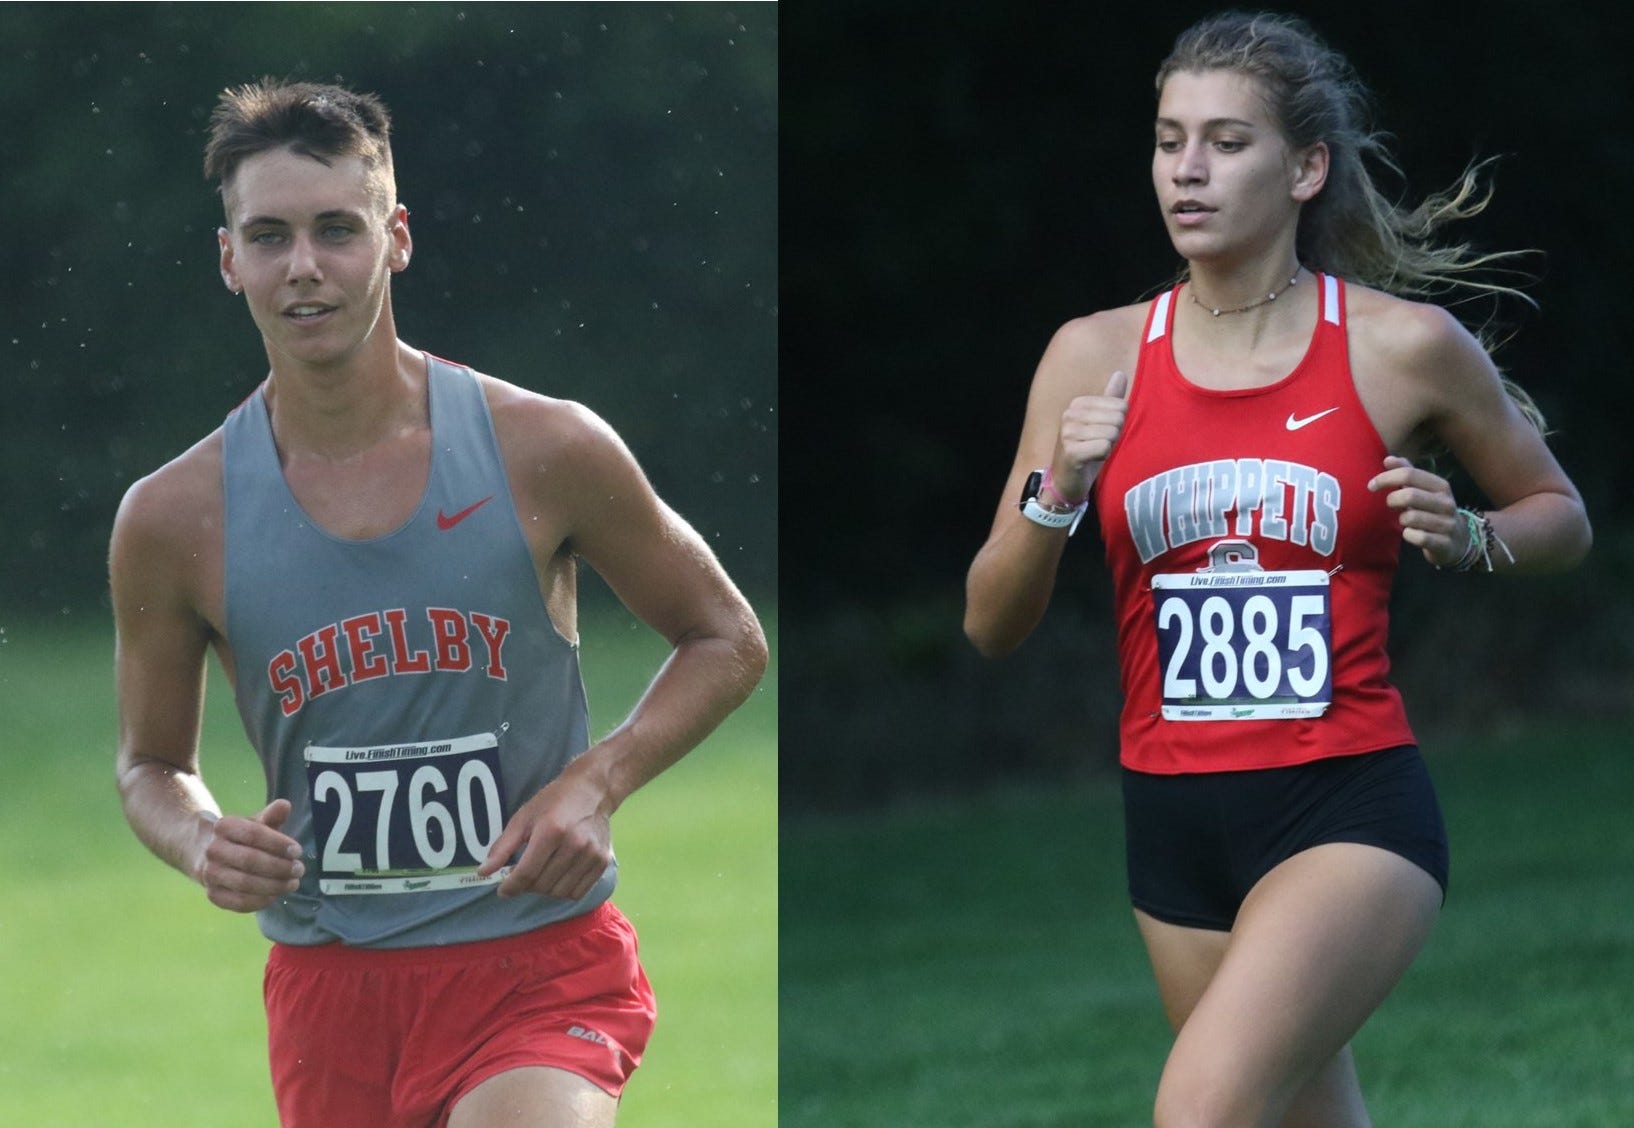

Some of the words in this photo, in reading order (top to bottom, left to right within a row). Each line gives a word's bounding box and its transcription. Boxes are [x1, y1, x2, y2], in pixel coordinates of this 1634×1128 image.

[1124, 457, 1341, 565] WHIPPETS
[1190, 575, 1287, 586] Live.FinishTiming.com
[268, 607, 510, 717] SHELBY
[1158, 594, 1328, 699] 2885
[345, 743, 452, 761] Live.FinishTiming.com
[314, 759, 502, 873] 2760
[566, 1025, 614, 1049] BAL
